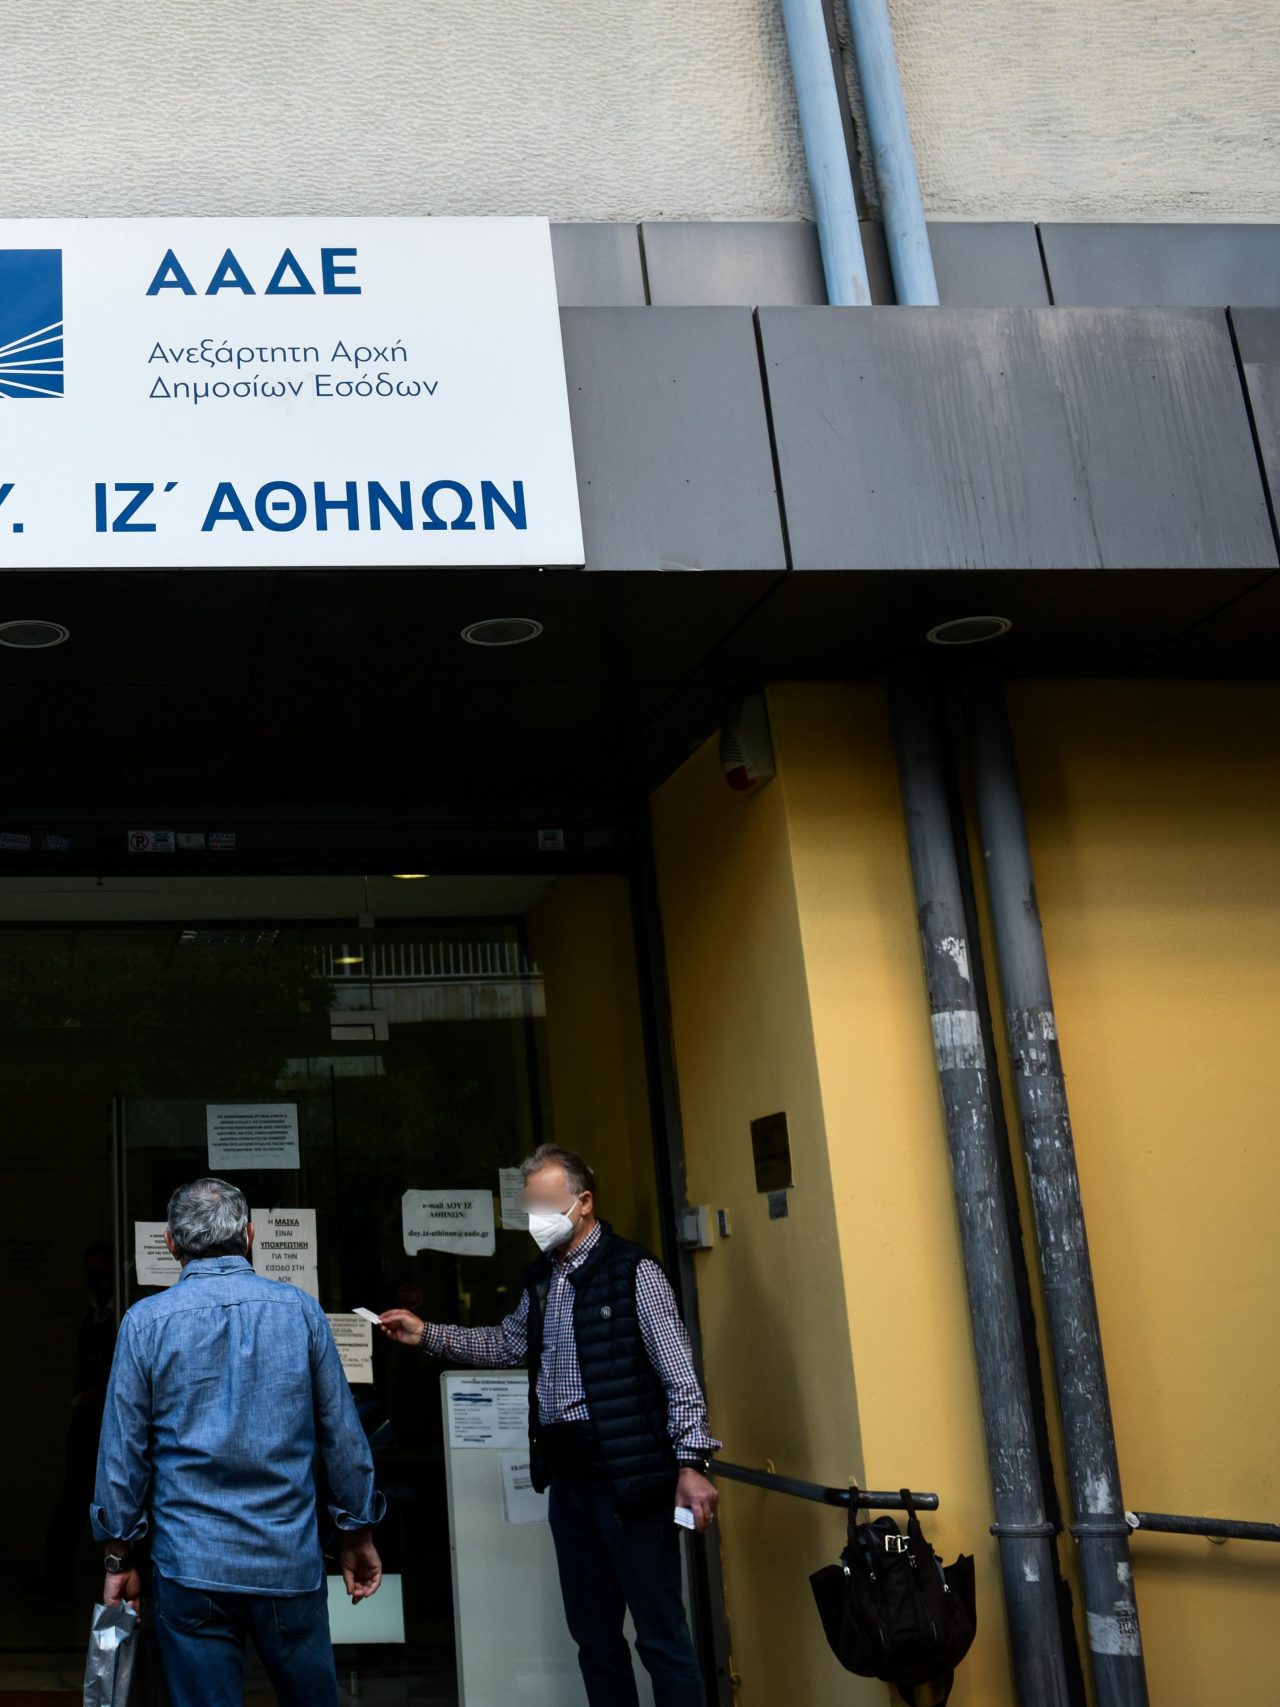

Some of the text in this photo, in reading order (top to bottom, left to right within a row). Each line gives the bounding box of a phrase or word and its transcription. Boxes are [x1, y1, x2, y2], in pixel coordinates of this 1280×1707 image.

[145, 247, 362, 296] ΑΑΔΕ
[147, 338, 408, 369] Ανεξάρτητη Αρχή
[149, 372, 439, 405] Δημοσίων Εσόδων
[200, 479, 528, 533] ΑΘΗΝΩΝ
[274, 1218, 300, 1226] ΜΑΣΚΑ
[260, 1241, 309, 1249] ΥΠΟΧΡΕΩΤΙΚΗ
